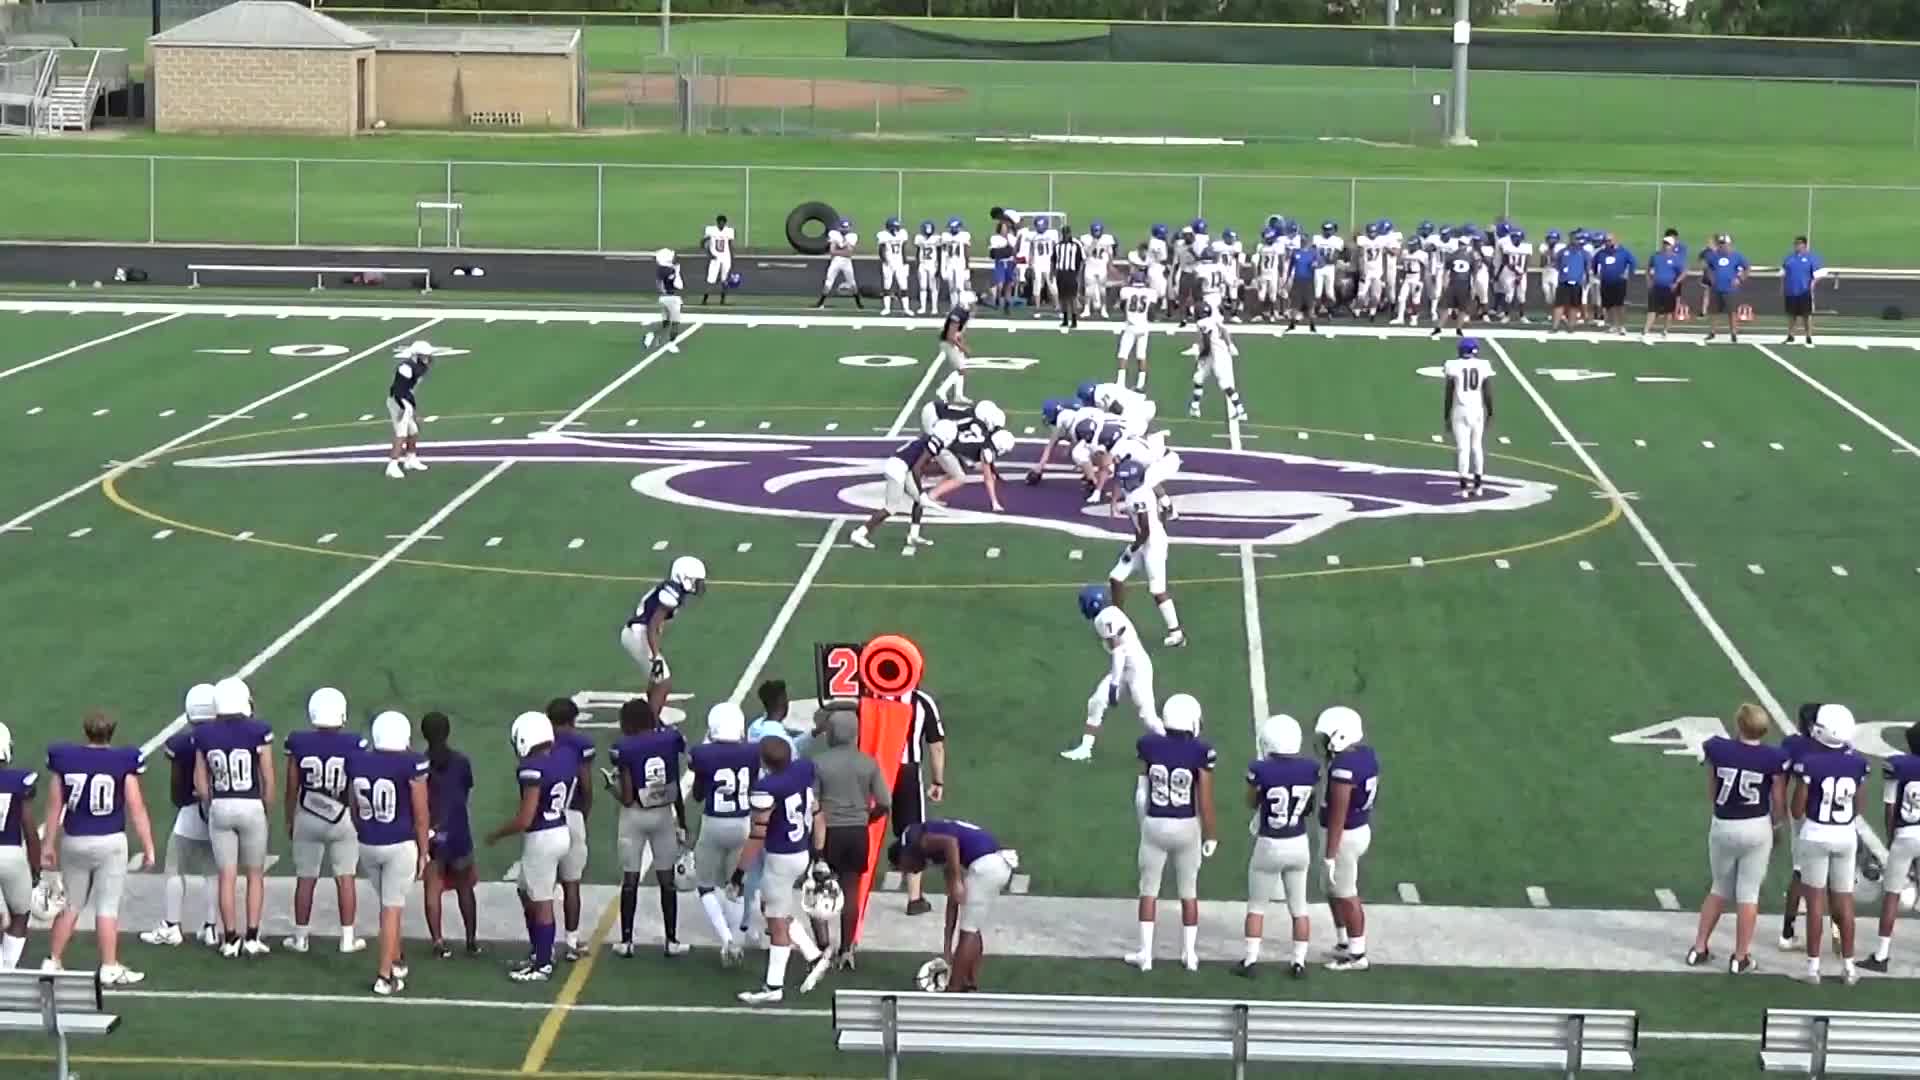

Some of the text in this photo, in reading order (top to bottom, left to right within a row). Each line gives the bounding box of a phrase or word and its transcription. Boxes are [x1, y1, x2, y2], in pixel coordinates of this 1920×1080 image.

[1461, 367, 1479, 392] 10
[827, 647, 860, 697] 2
[64, 773, 115, 817] 70
[713, 766, 751, 813] 21
[1266, 784, 1313, 830] 37
[1716, 767, 1765, 806] 75
[1818, 776, 1857, 824] 19
